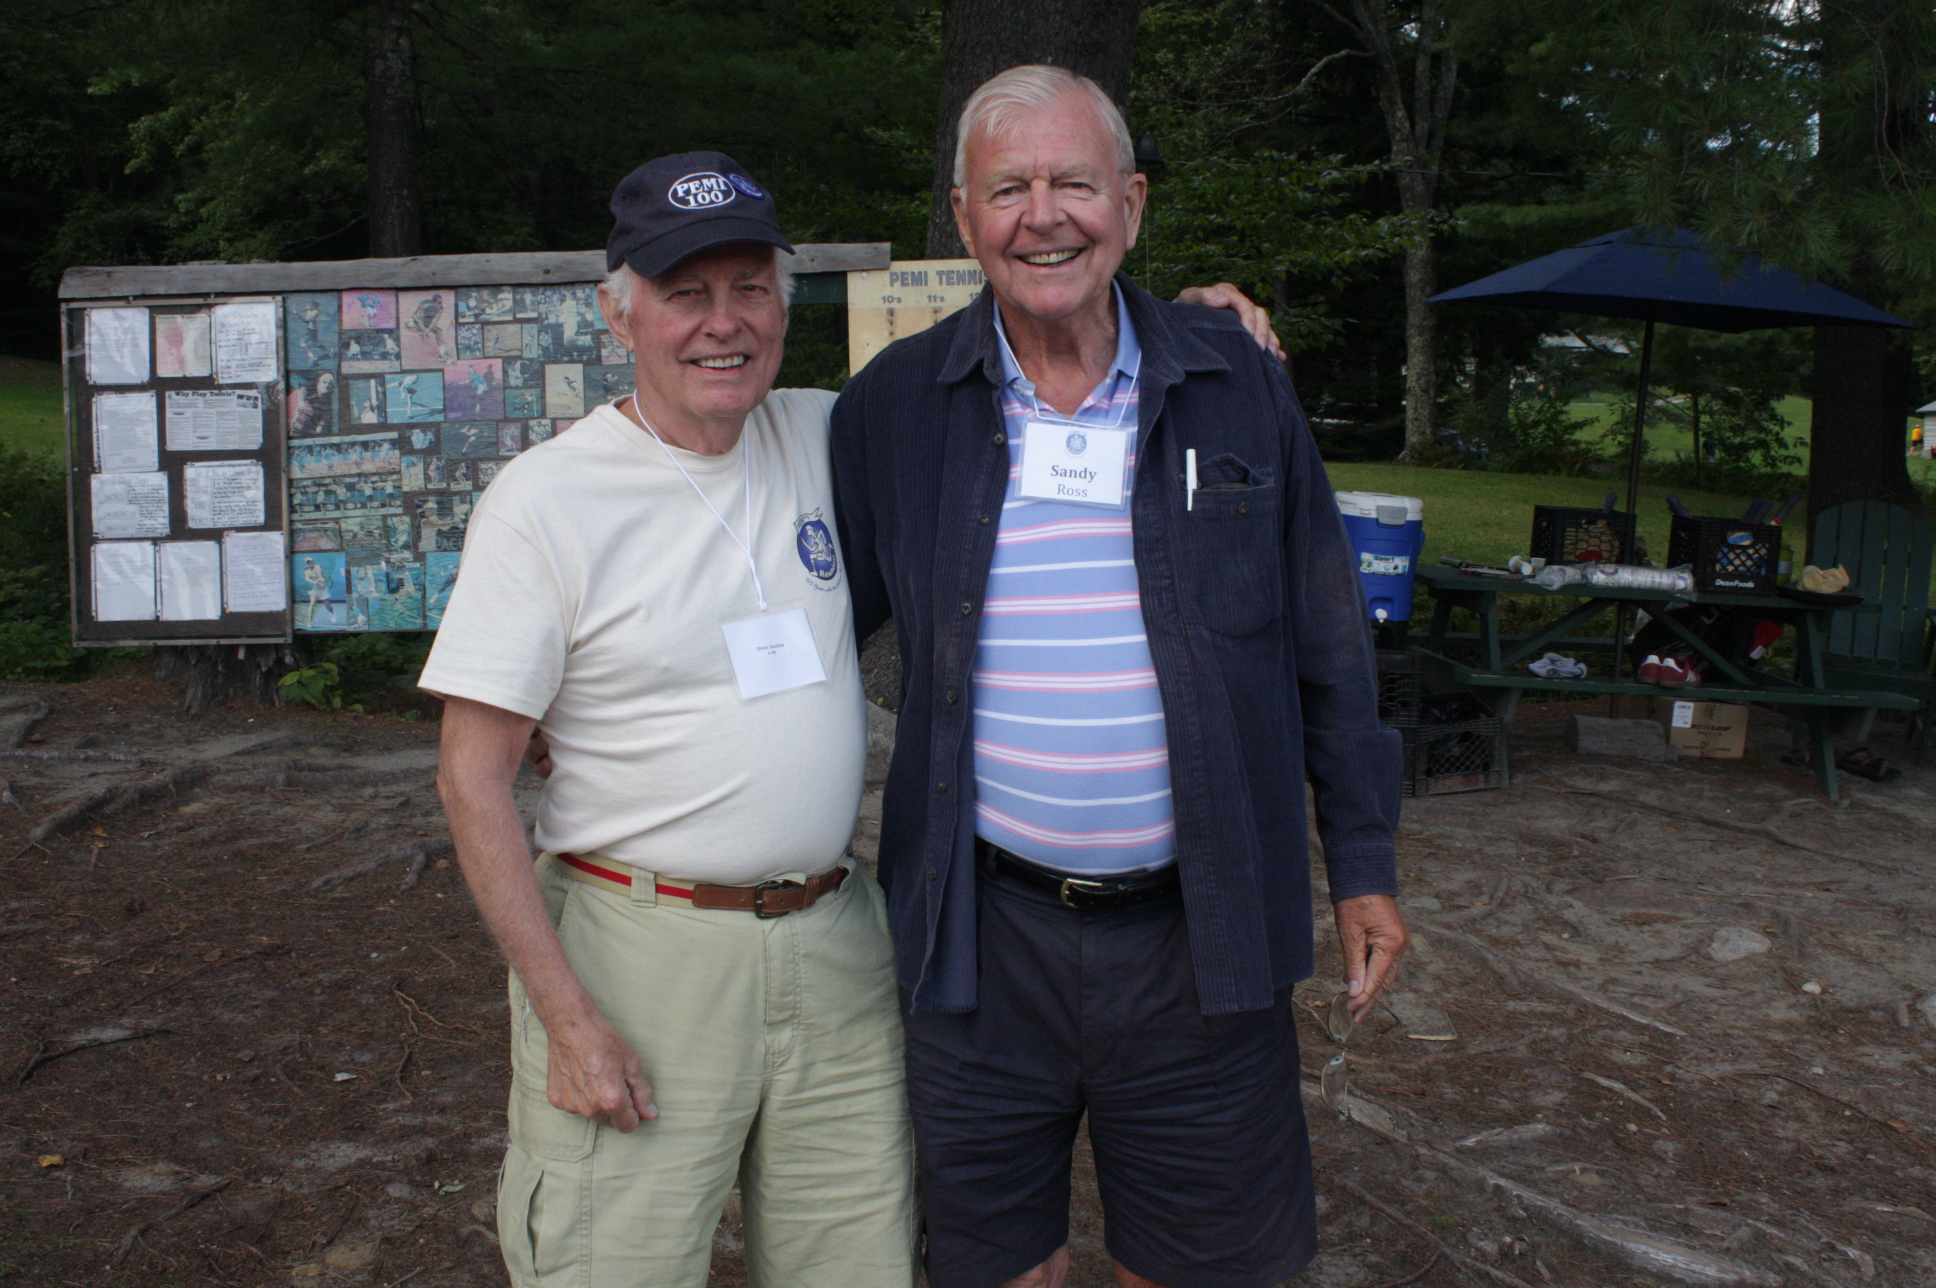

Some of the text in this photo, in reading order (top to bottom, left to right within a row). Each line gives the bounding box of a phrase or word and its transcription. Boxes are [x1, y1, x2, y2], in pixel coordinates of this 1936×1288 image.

[675, 177, 727, 198] PEMI
[685, 190, 724, 207] 100
[889, 269, 988, 287] PEMI TENNI
[1050, 464, 1097, 483] Sandy
[1057, 483, 1088, 498] Ross
[819, 554, 836, 578] Reunion
[1691, 723, 1731, 732] DUNLOP
